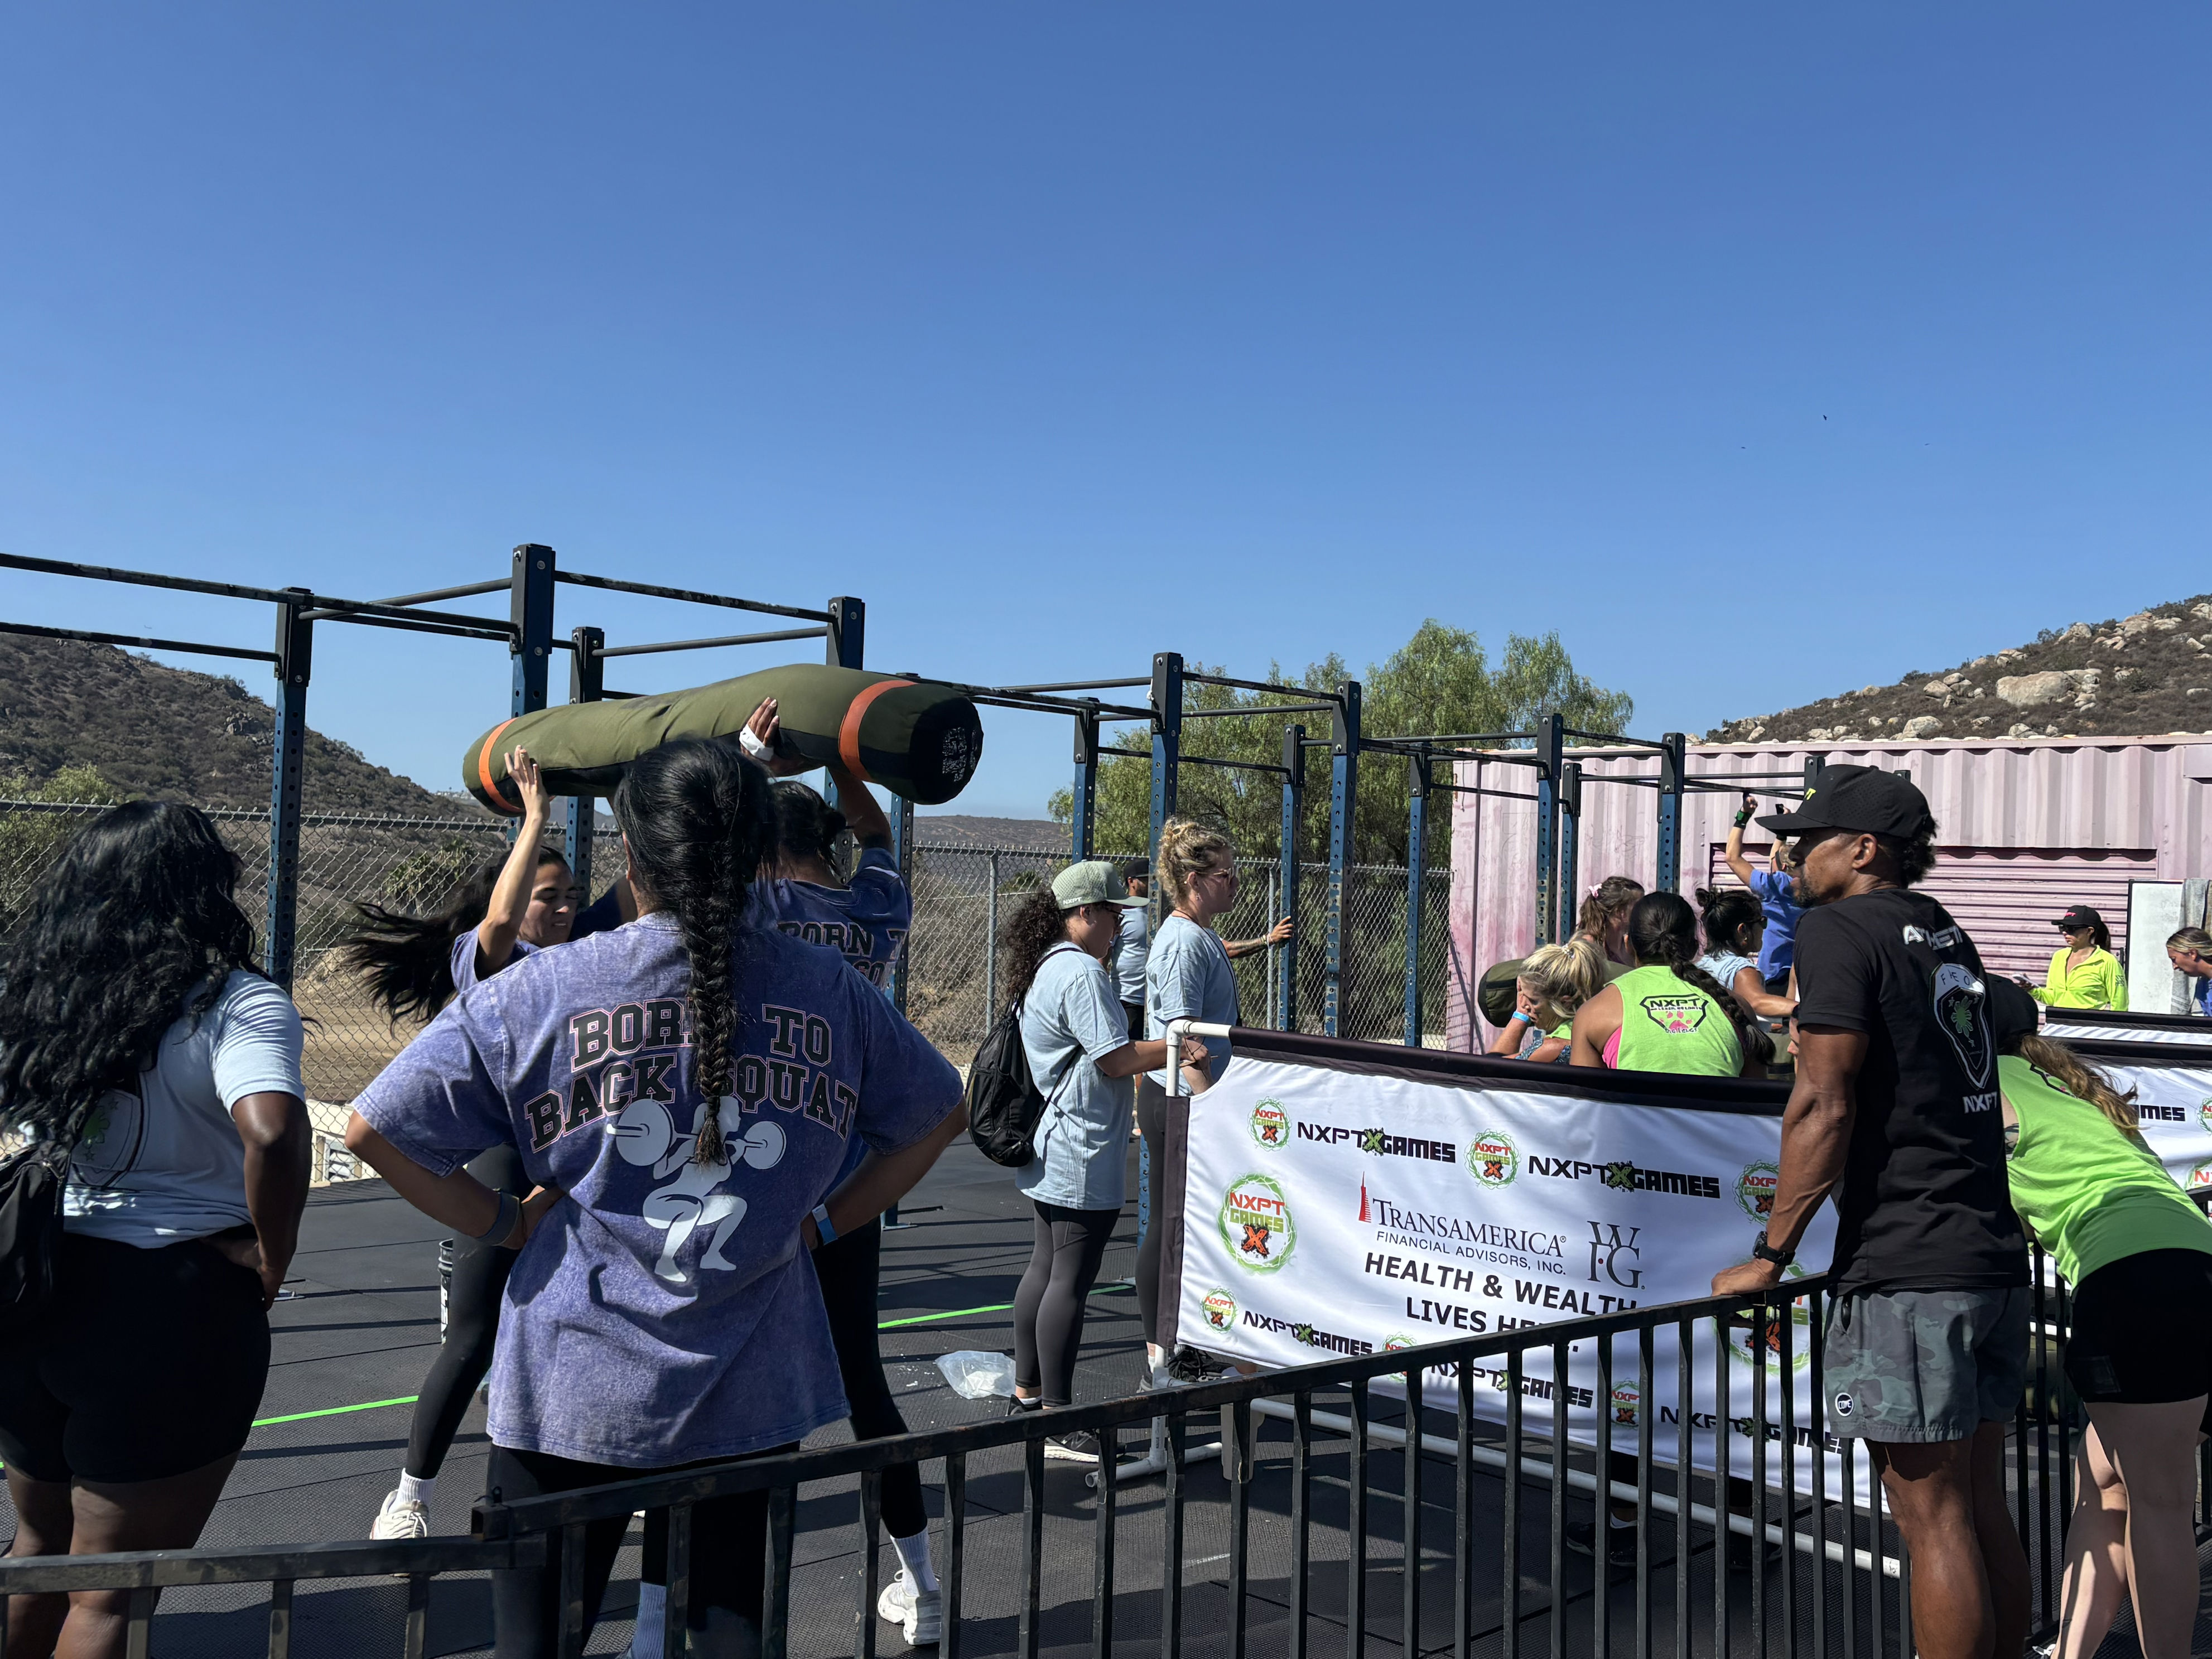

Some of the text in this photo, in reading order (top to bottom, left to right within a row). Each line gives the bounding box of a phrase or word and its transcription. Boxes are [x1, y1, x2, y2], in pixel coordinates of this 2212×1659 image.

[1650, 998, 1700, 1007] NXPT
[763, 1004, 831, 1067] TO
[524, 1052, 677, 1154] BACK
[1255, 1108, 1285, 1121] NXPT
[1255, 1117, 1284, 1130] GAMES
[1475, 1142, 1512, 1156] NXPT
[1475, 1152, 1510, 1166] GAMES
[1743, 1175, 1777, 1188] NXP
[1230, 1192, 1285, 1216] NXPT
[1230, 1208, 1284, 1234] GAMES
[1377, 1231, 1566, 1275] FINANCIAL ADVISORS, INC.
[1365, 1252, 1474, 1293] HEALTH
[1483, 1275, 1503, 1299] &
[1205, 1296, 1234, 1309] NXPT
[1407, 1297, 1487, 1333] LIVES
